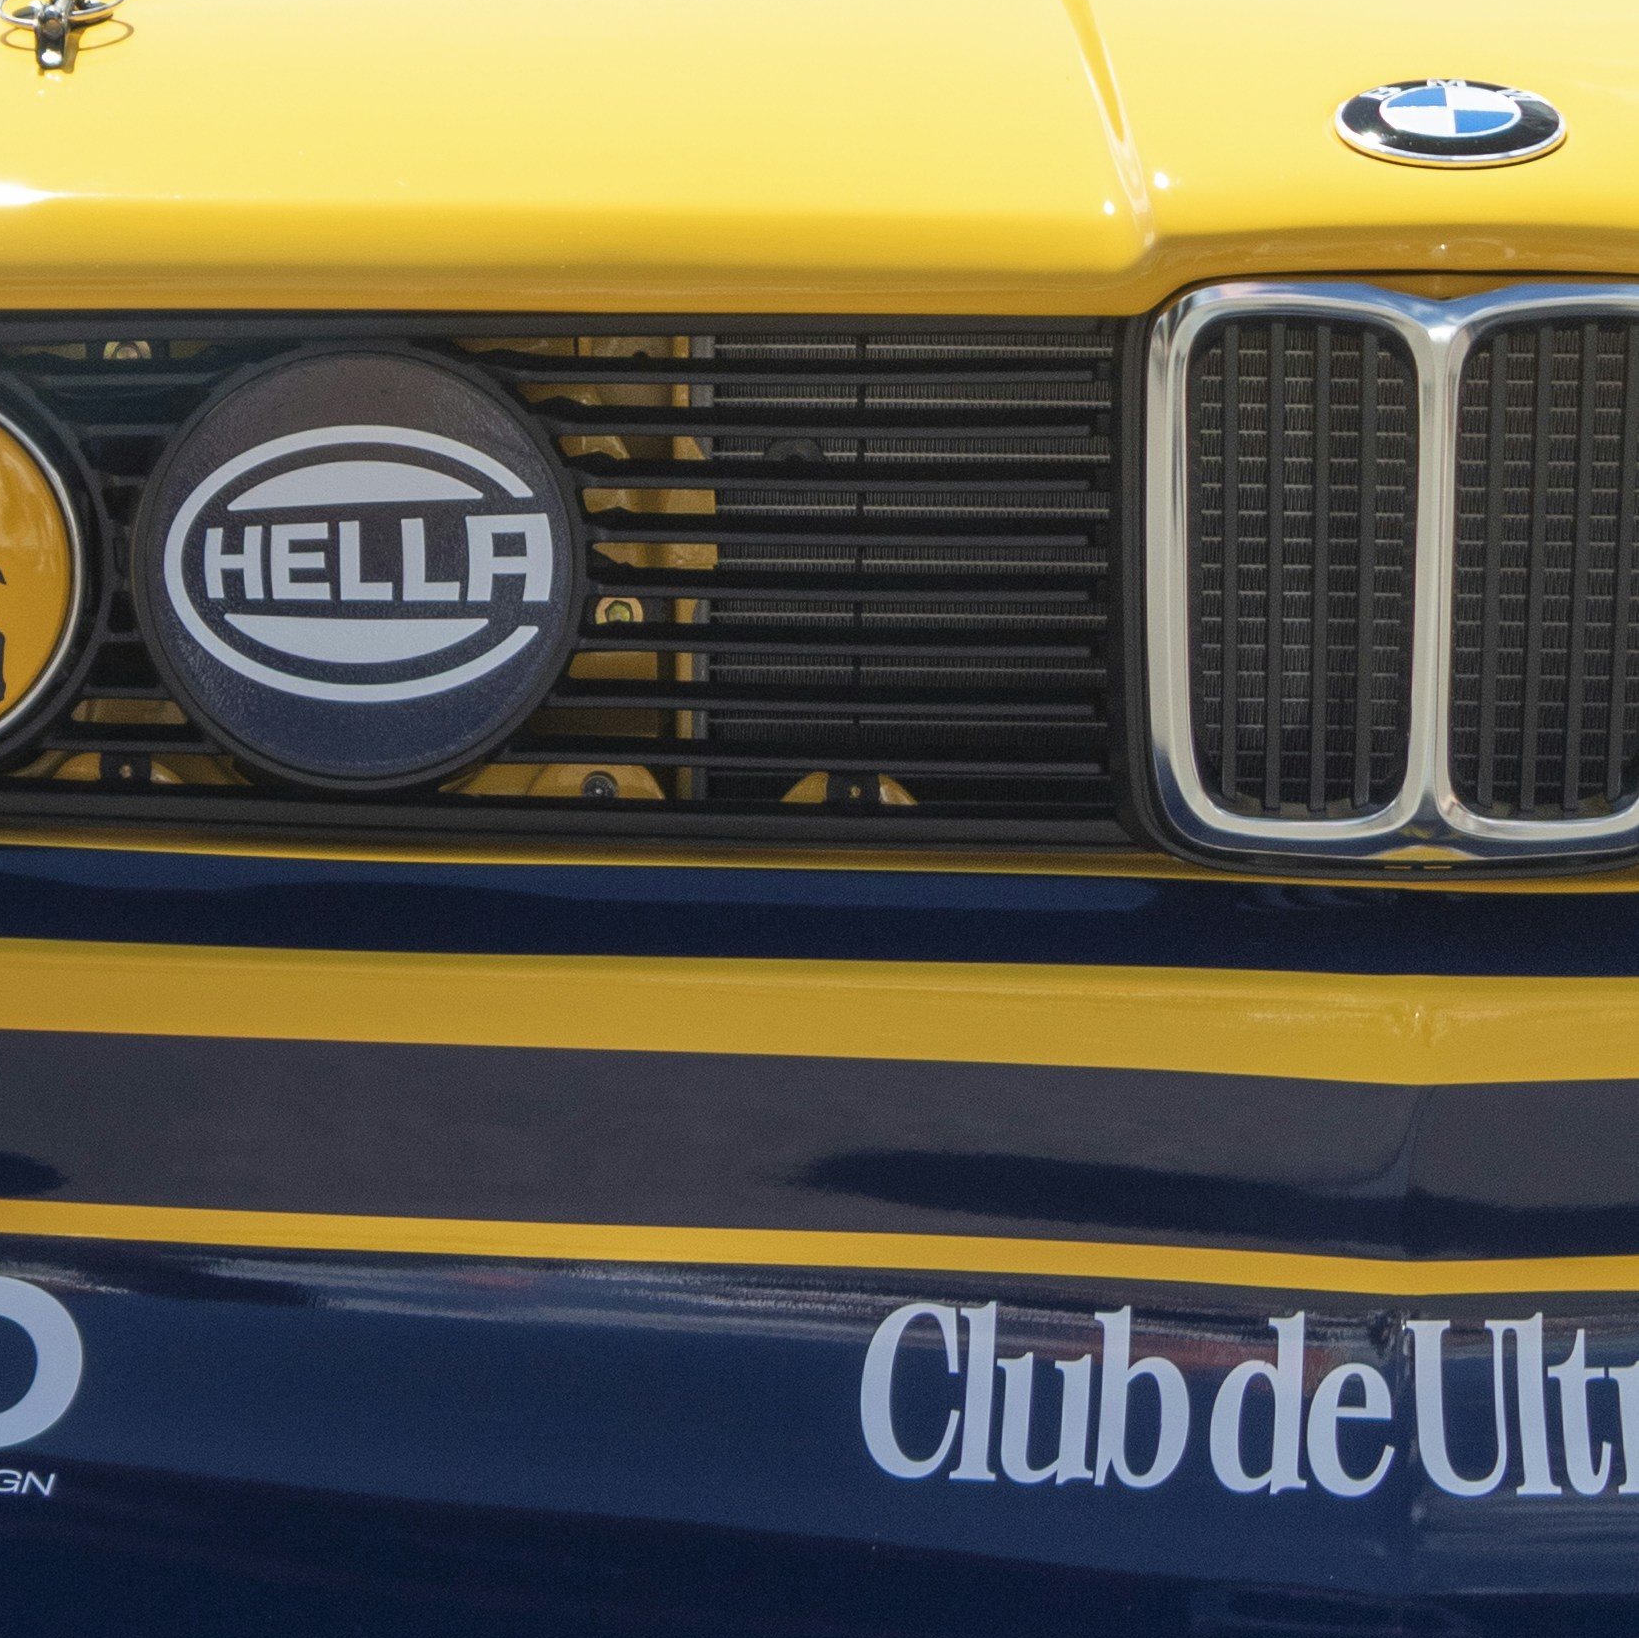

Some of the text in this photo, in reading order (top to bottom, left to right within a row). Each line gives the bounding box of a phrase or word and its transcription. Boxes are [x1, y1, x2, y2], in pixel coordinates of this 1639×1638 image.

[204, 513, 554, 602] HELLA
[860, 1301, 1191, 1488] Club
[1209, 1311, 1395, 1496] de
